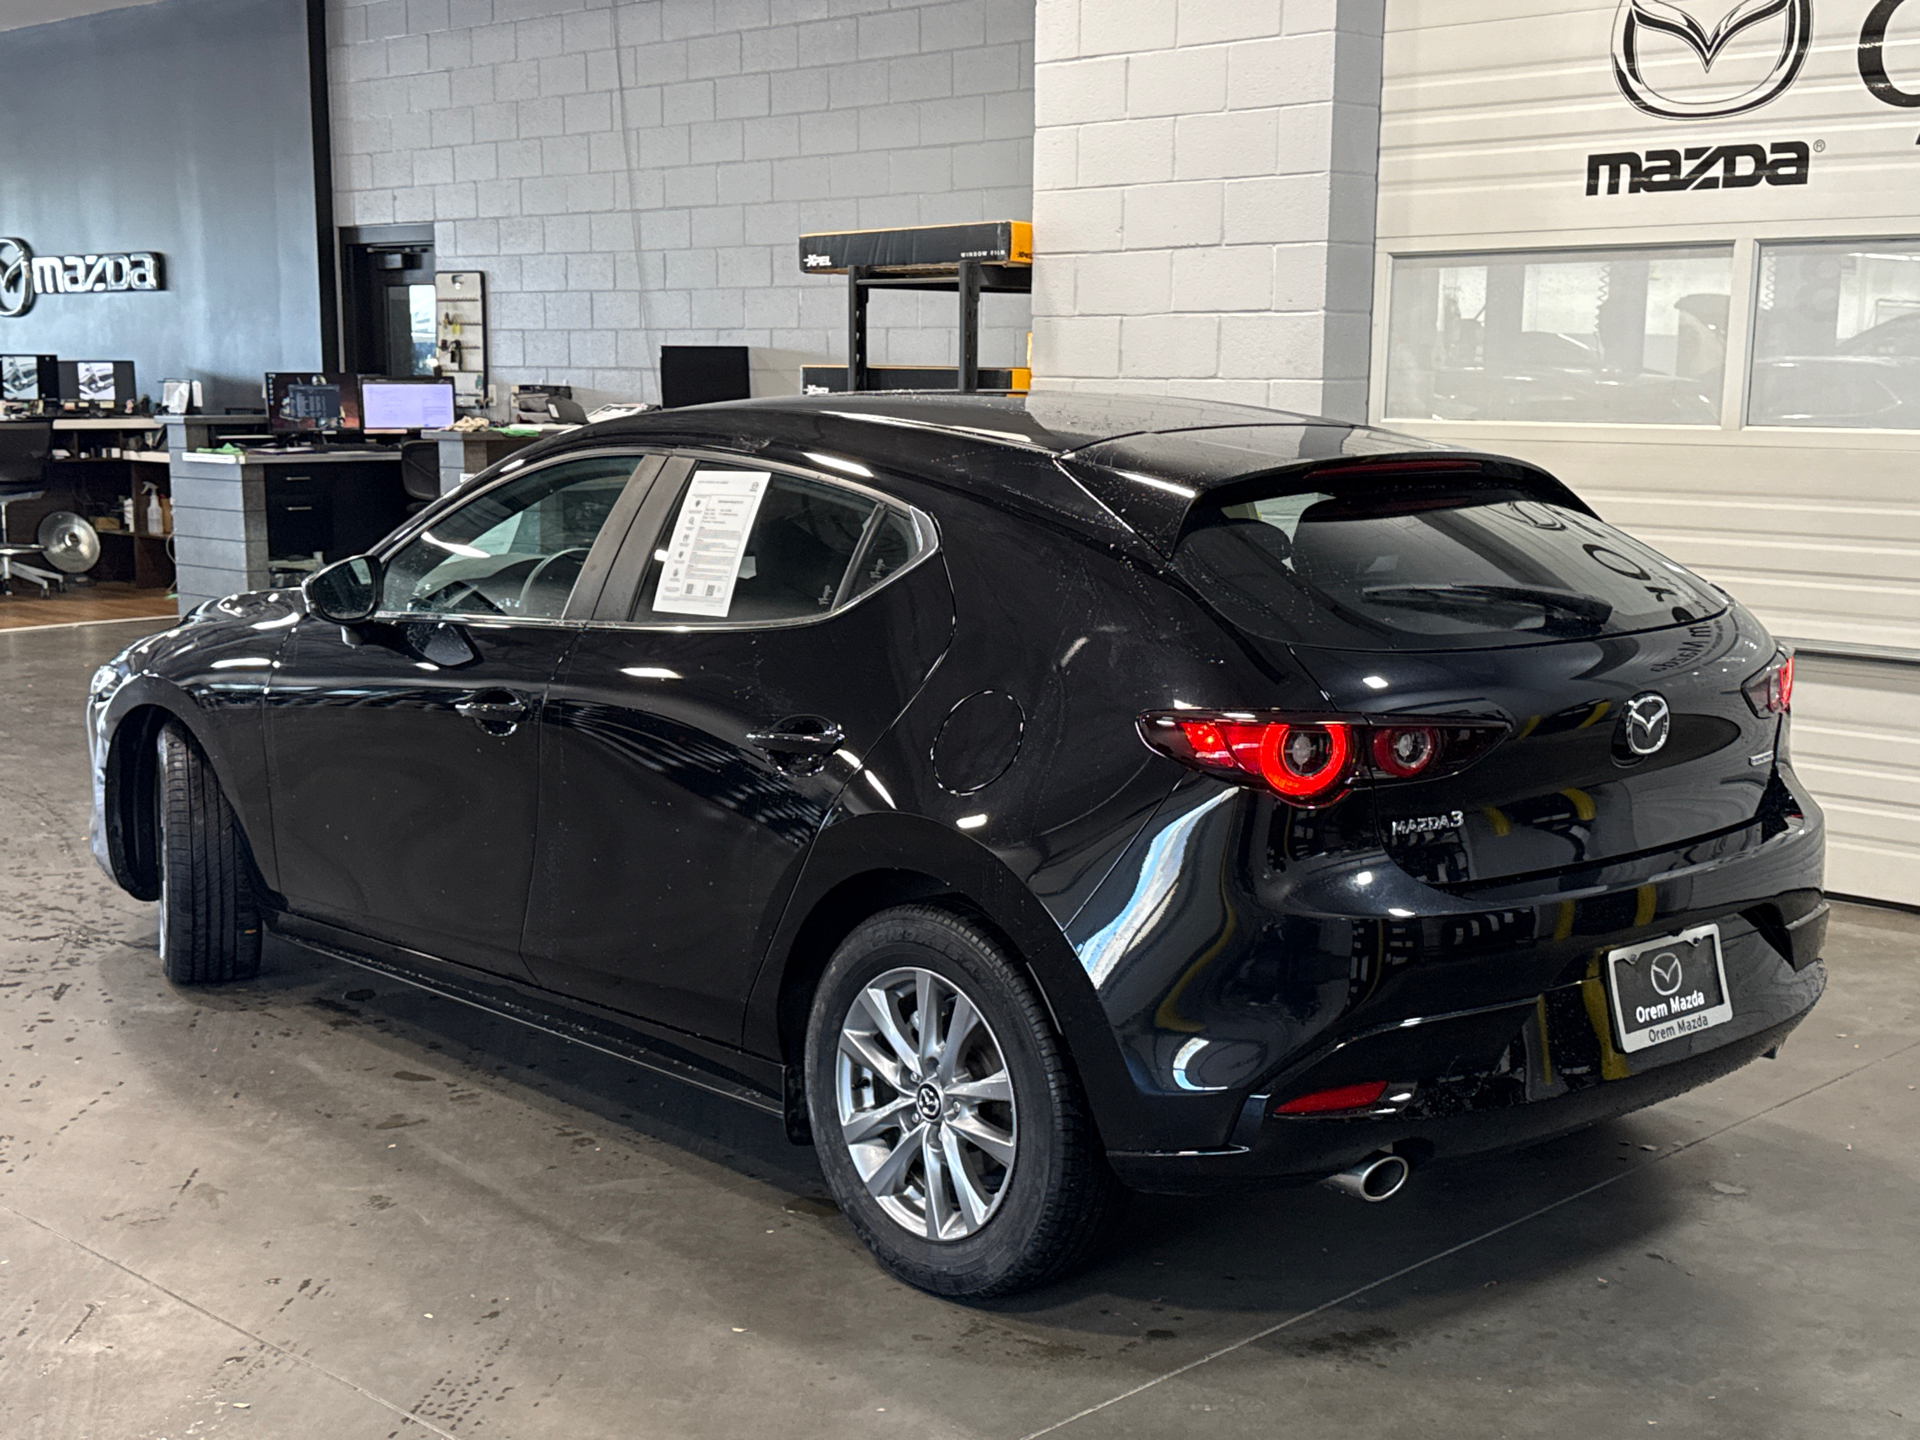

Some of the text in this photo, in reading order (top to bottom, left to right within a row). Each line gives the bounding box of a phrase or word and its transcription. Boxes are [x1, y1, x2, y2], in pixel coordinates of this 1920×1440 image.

[803, 254, 832, 267] XPEL
[960, 249, 1006, 258] WINDOW FILM
[1636, 990, 1705, 1023] Orem Mazda
[1648, 1014, 1708, 1043] Orem Mazda
